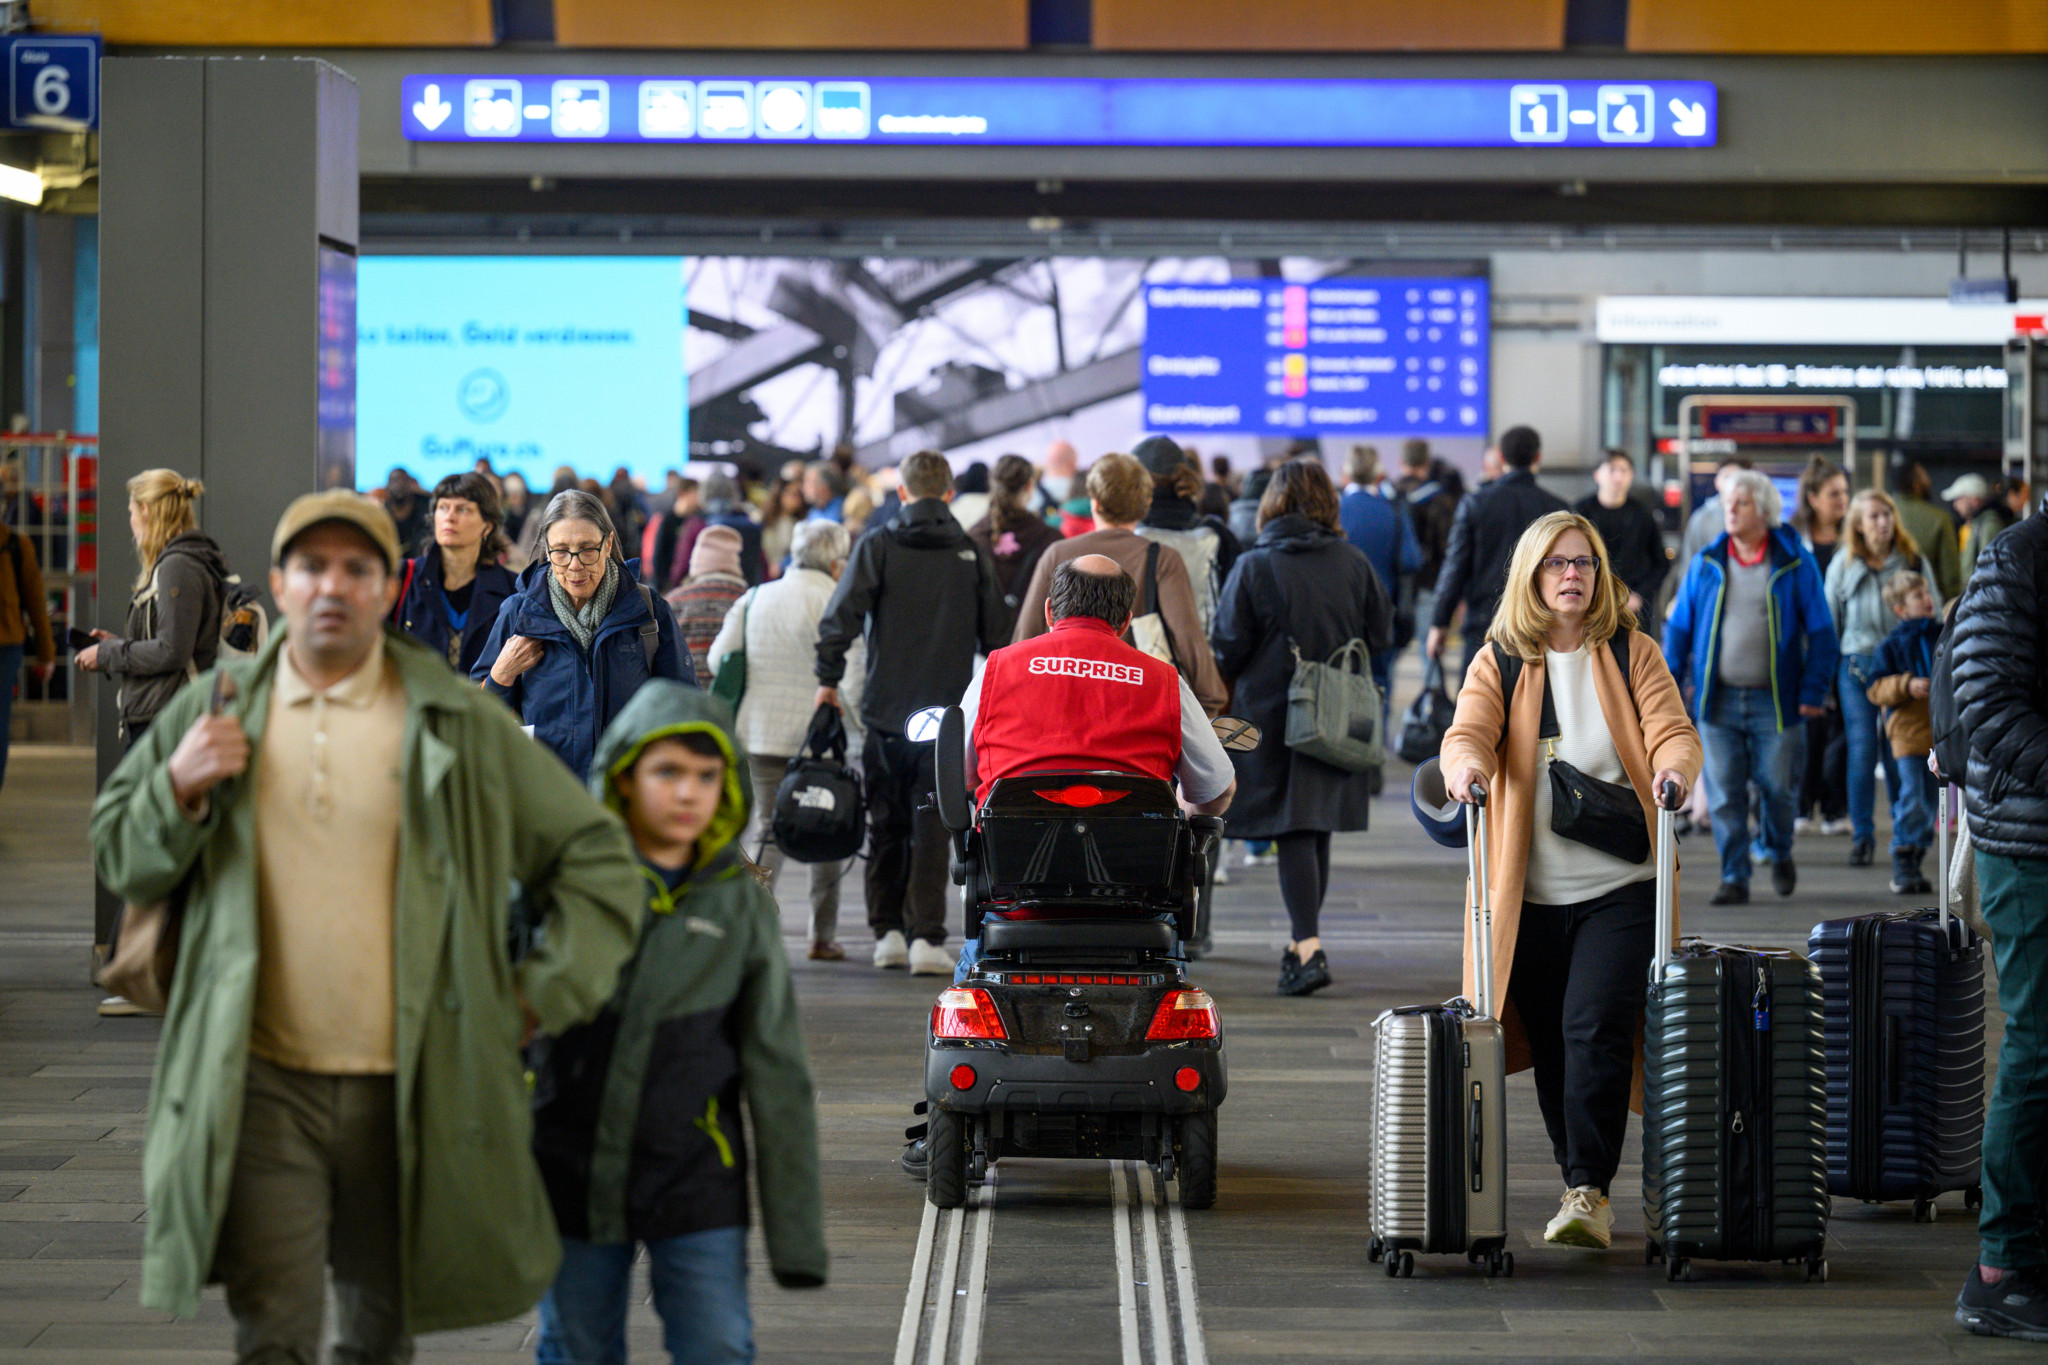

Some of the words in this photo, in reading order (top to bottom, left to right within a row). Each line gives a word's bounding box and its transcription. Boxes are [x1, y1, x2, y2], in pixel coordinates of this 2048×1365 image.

[33, 64, 70, 115] 6
[1528, 104, 1547, 136] 1
[1613, 105, 1639, 136] 4
[1029, 657, 1143, 685] SURPRISE
